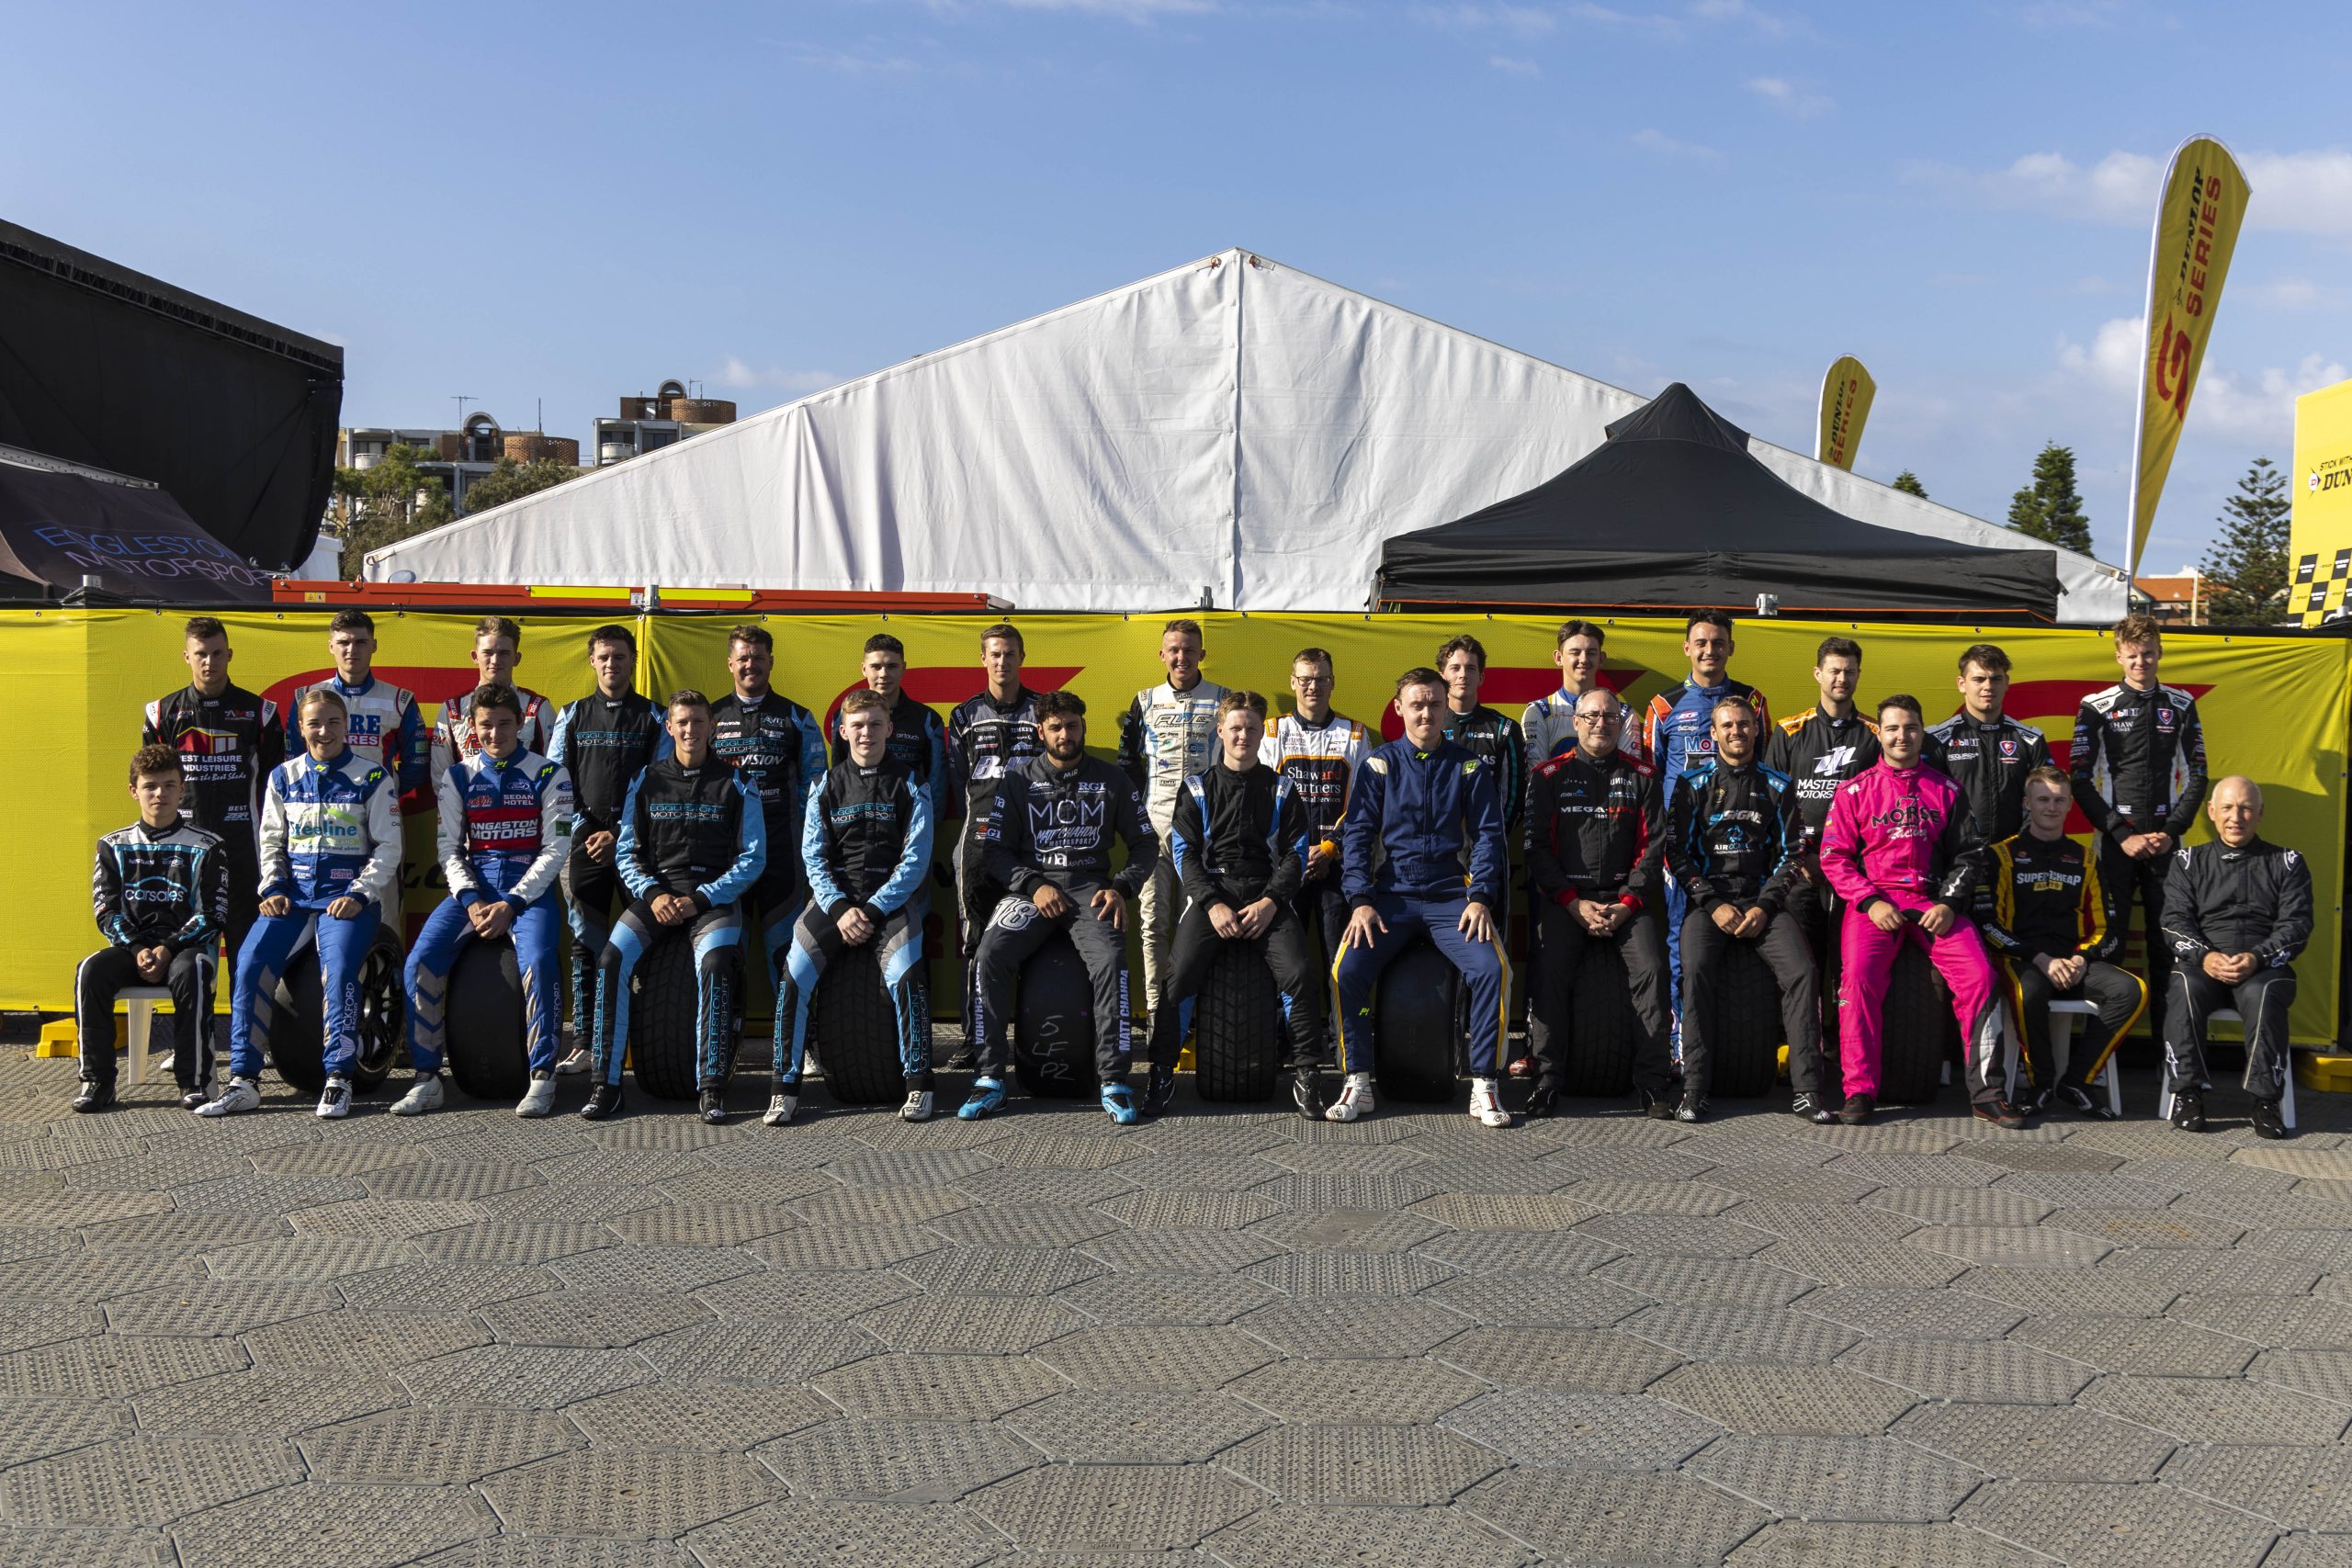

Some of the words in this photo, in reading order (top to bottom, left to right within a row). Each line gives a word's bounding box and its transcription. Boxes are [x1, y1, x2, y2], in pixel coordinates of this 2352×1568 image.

[2180, 166, 2203, 283] DUNLOP
[2186, 175, 2221, 318] SERIES
[2320, 459, 2336, 471] STICK
[1287, 767, 1319, 779] Shaw
[1321, 769, 1342, 780] and
[1078, 782, 1106, 790] RGI
[1317, 795, 1341, 803] Services
[1796, 790, 1834, 799] MOTORS
[650, 811, 726, 820] MOTORSPORT
[831, 811, 897, 823] MOTORSPOR
[1028, 799, 1105, 826] MCM
[1871, 806, 1941, 828] MORSE
[288, 819, 357, 837] Steeline
[470, 818, 538, 830] ANGASTON
[470, 827, 537, 840] MOTORS
[987, 828, 1001, 838] GI
[1037, 829, 1058, 844] MATT
[1886, 828, 1928, 841] Racing
[1048, 838, 1092, 846] MOTORSPORT
[124, 888, 185, 903] carsales
[1118, 969, 1130, 1017] CHAHDA
[341, 982, 355, 1033] TICKFORD
[707, 987, 720, 1076] EGGLESTON
[718, 974, 729, 1077] MOTORSPORT
[1118, 1019, 1131, 1053] MATT
